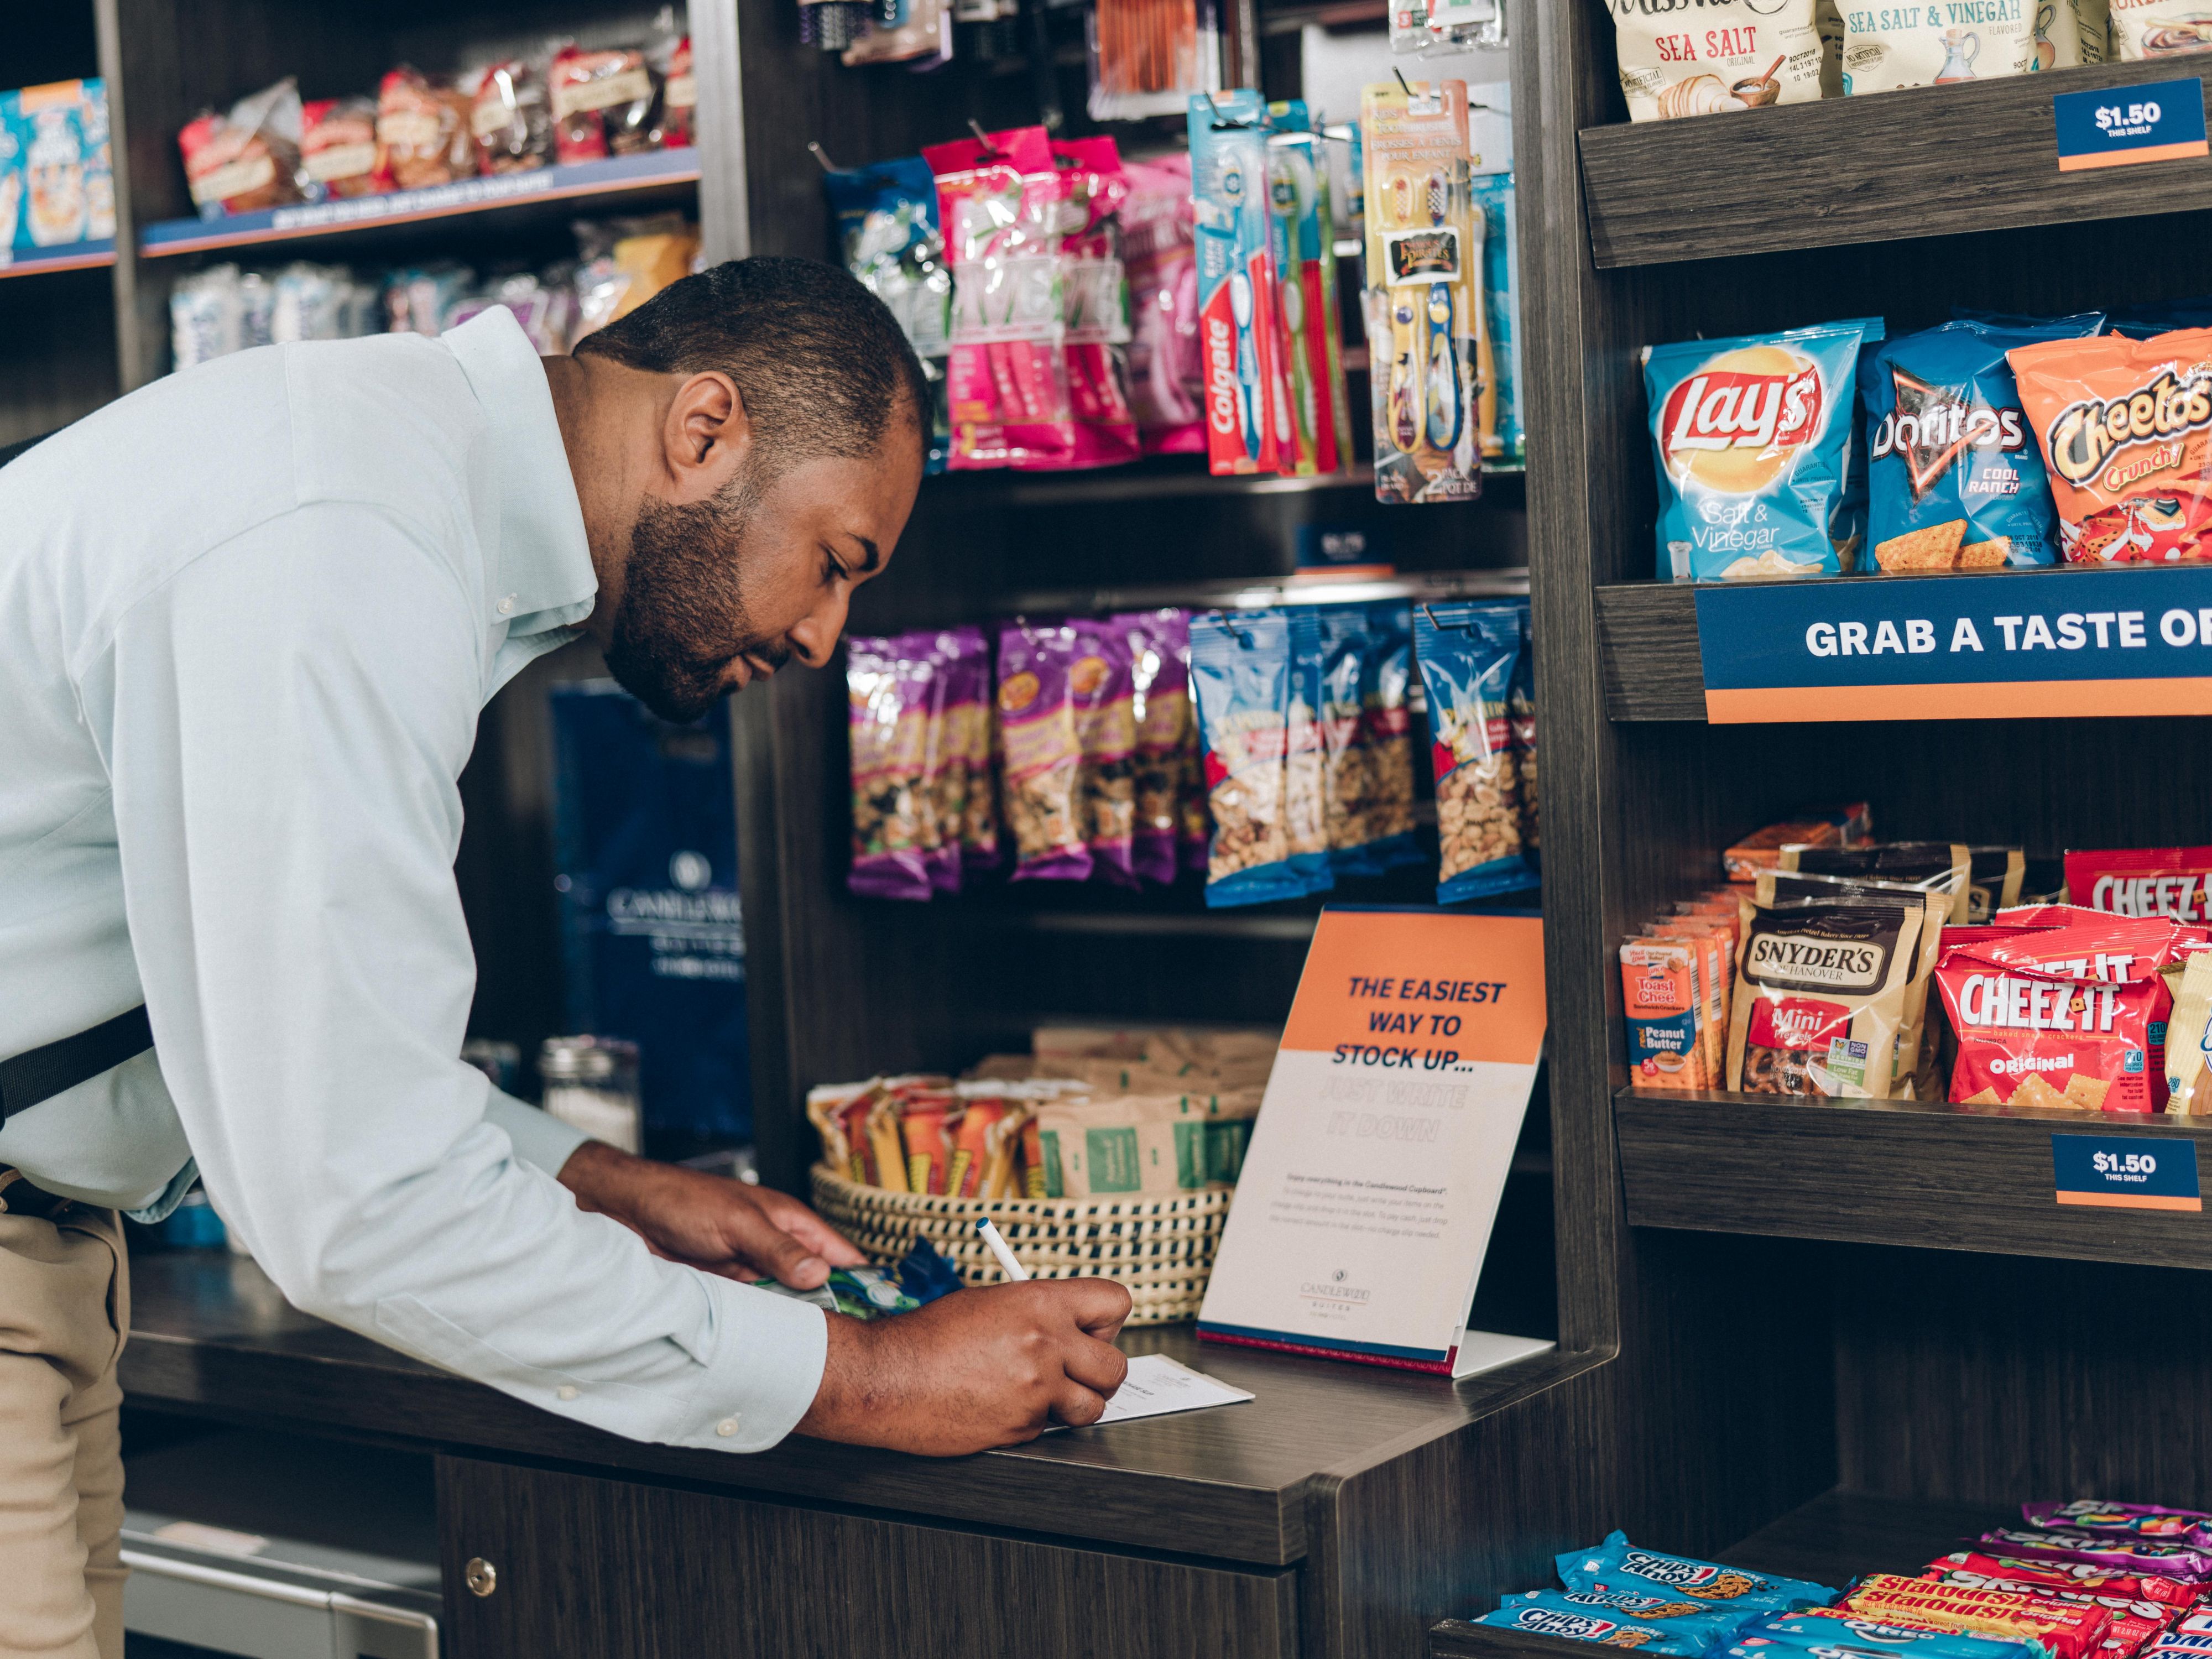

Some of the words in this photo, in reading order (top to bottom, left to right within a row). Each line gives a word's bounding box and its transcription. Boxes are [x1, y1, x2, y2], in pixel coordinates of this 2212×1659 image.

[1849, 11, 1876, 33] SEA
[1881, 8, 1920, 31] SALT
[1927, 6, 1943, 27] &
[1946, 0, 2022, 24] VINEGAR
[1989, 23, 2022, 35] FLAVORED
[1655, 34, 1697, 61] SEA
[1705, 27, 1756, 59] SALT
[1727, 56, 1755, 67] ORIGINAL
[2095, 102, 2161, 129] $1.50
[2107, 129, 2126, 137] THIS
[2127, 126, 2152, 135] SHELF
[1211, 316, 1235, 435] Colgate
[1668, 372, 1815, 451] Lay's
[1872, 403, 2023, 457] Doritos
[2054, 375, 2212, 479] Cheetos
[1983, 468, 2020, 481] COOL
[2104, 444, 2184, 490] Crunchy
[1426, 469, 1443, 494] 2
[1463, 481, 1477, 493] DE
[1968, 482, 2020, 494] RANCH
[1704, 501, 1749, 524] Salt
[1754, 504, 1767, 523] &
[1692, 526, 1780, 551] Vinegar
[1806, 619, 1936, 656] GRAB
[1950, 618, 1984, 651] A
[1994, 611, 2147, 651] TASTE
[1755, 940, 1874, 973] SNYDER'S
[1788, 966, 1843, 980] HANOVER
[1349, 978, 1394, 998] THE
[1400, 979, 1506, 1003] EASIEST
[1636, 977, 1675, 992] Toast
[1637, 990, 1676, 1004] Chee
[1369, 1011, 1423, 1034] WAY
[1430, 1015, 1462, 1036] TO
[1771, 1008, 1823, 1031] Mini
[2150, 1024, 2167, 1034] 210
[1646, 1026, 1685, 1040] Peanut
[2048, 1032, 2084, 1041] crackers
[1647, 1038, 1683, 1050] Butter
[1332, 1043, 1417, 1070] STOCK
[1423, 1050, 1474, 1073] UP...
[1386, 1079, 1470, 1110] WRITE
[1355, 1112, 1441, 1143] DOWN
[2093, 1151, 2157, 1173] $1.50
[1364, 1181, 1408, 1192] Candlewood
[2124, 1174, 2147, 1183] SHELF
[1629, 1553, 1696, 1574] Chips
[2031, 1599, 2092, 1610] Original
[1522, 1610, 1598, 1627] Chips
[1950, 1621, 1965, 1630] fruit
[2020, 1610, 2083, 1626] Original
[1843, 1620, 1936, 1640] OREO
